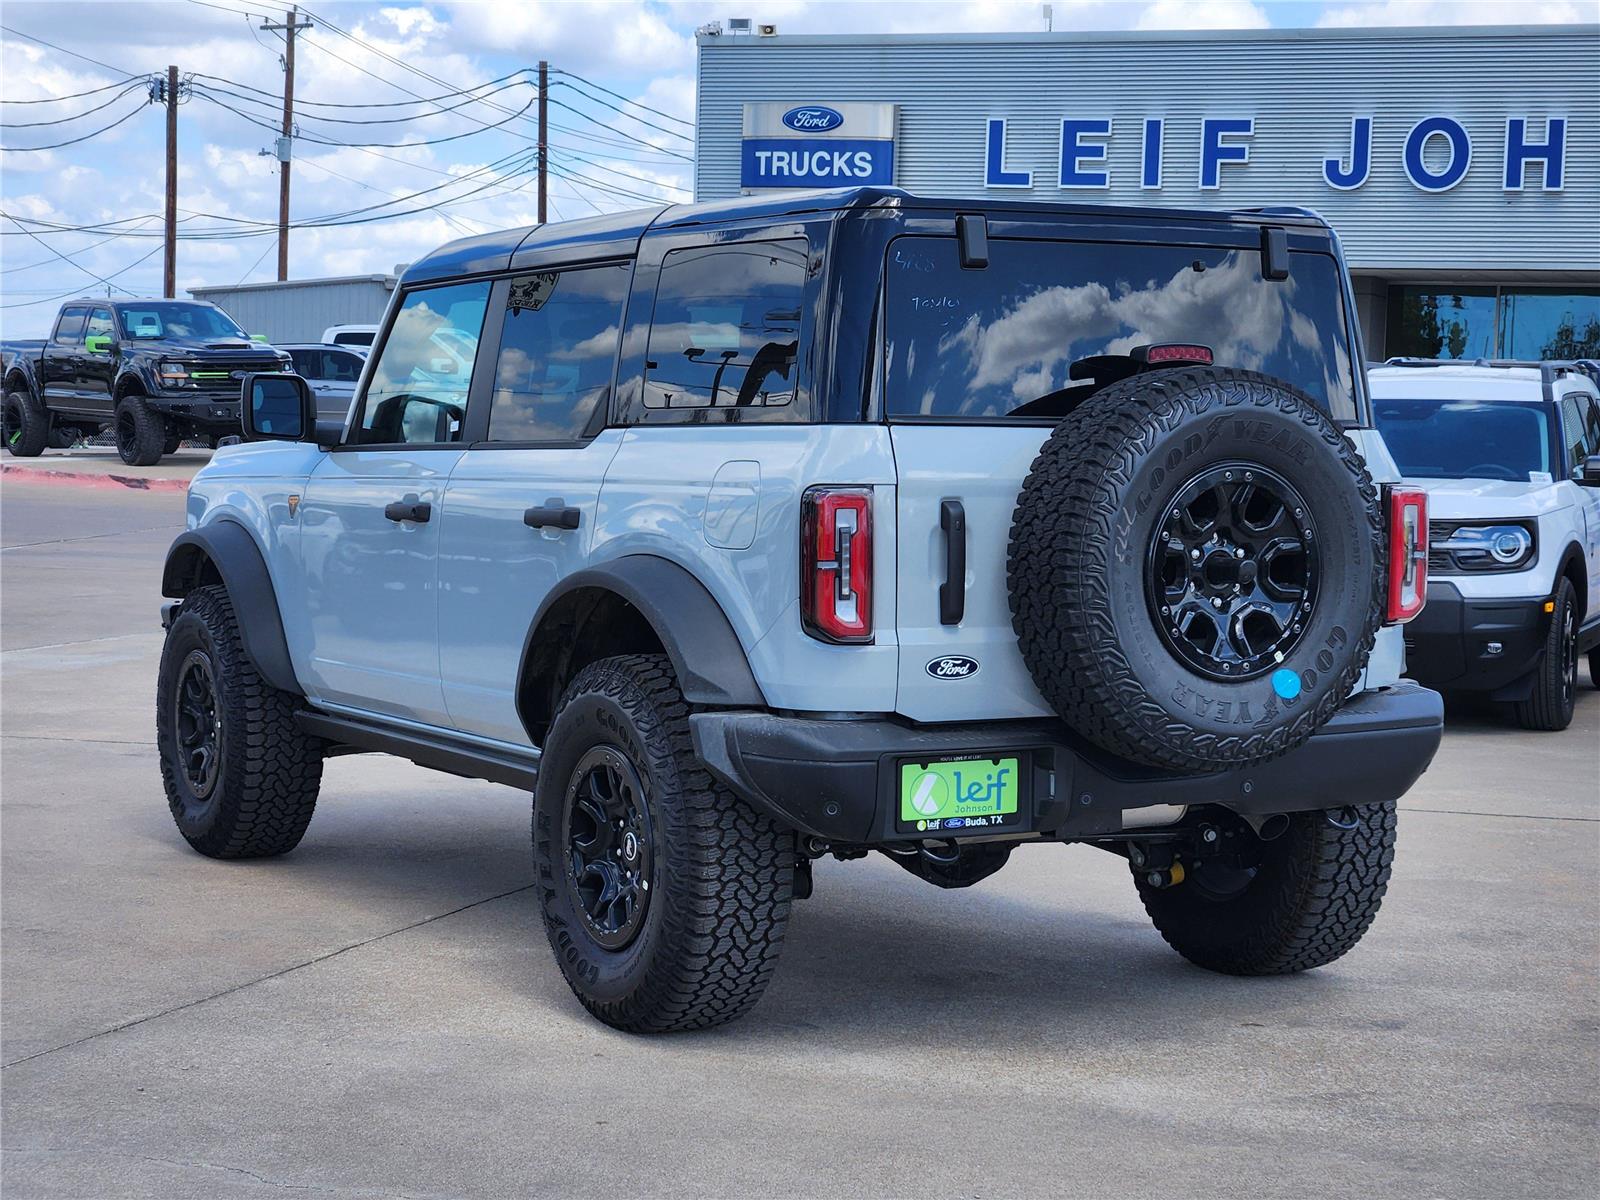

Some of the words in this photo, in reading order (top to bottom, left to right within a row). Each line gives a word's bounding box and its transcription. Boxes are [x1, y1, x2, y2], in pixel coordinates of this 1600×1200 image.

[754, 150, 873, 178] TRUCKS
[984, 117, 1255, 190] LEIF
[1322, 116, 1568, 194] JOH
[936, 659, 971, 676] Ford
[953, 768, 1010, 811] leif
[955, 805, 993, 814] Johnson
[965, 816, 989, 827] Buda,
[990, 815, 1003, 825] TX
